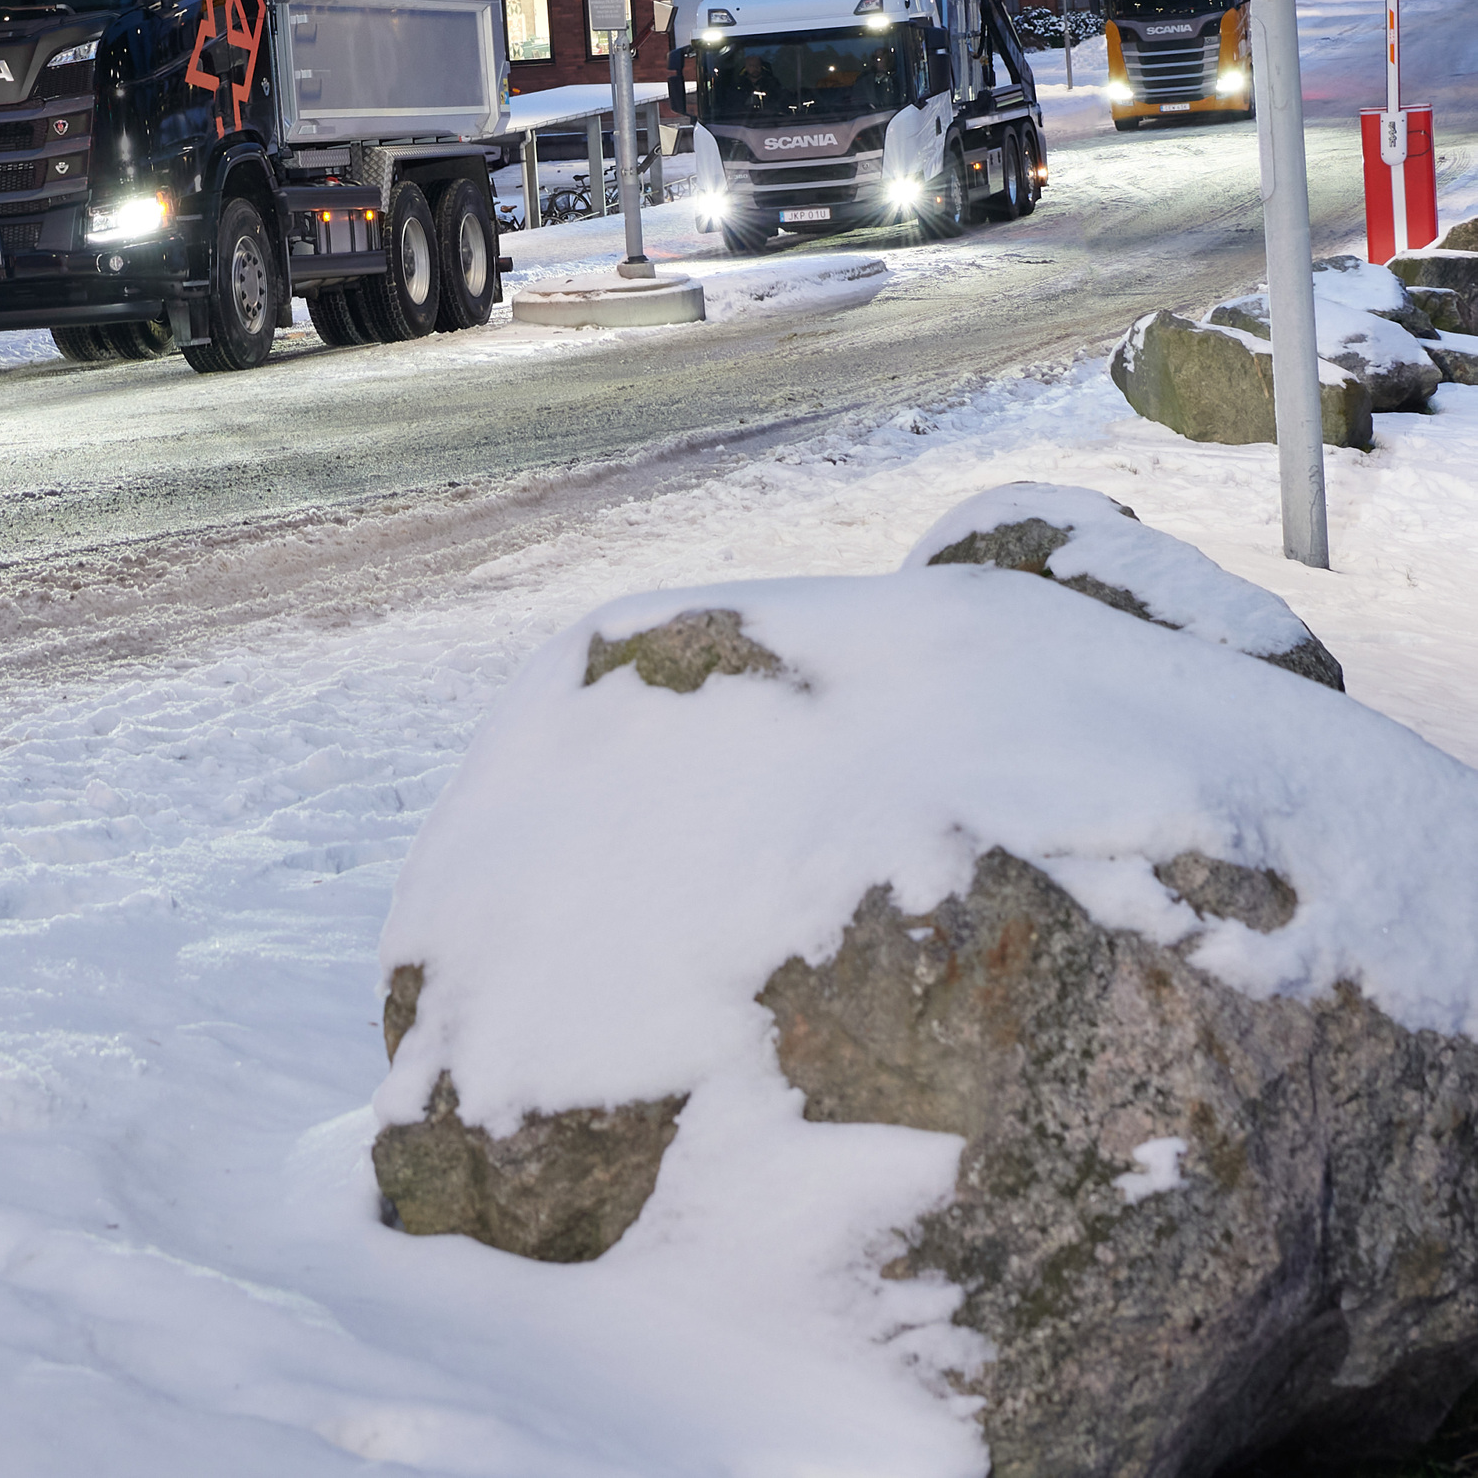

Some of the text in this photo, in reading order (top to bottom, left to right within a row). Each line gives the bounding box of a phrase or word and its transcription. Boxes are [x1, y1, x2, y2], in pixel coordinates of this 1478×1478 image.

[1146, 24, 1193, 35] SCANIA
[764, 133, 838, 151] SCANIA
[788, 211, 805, 221] JKP
